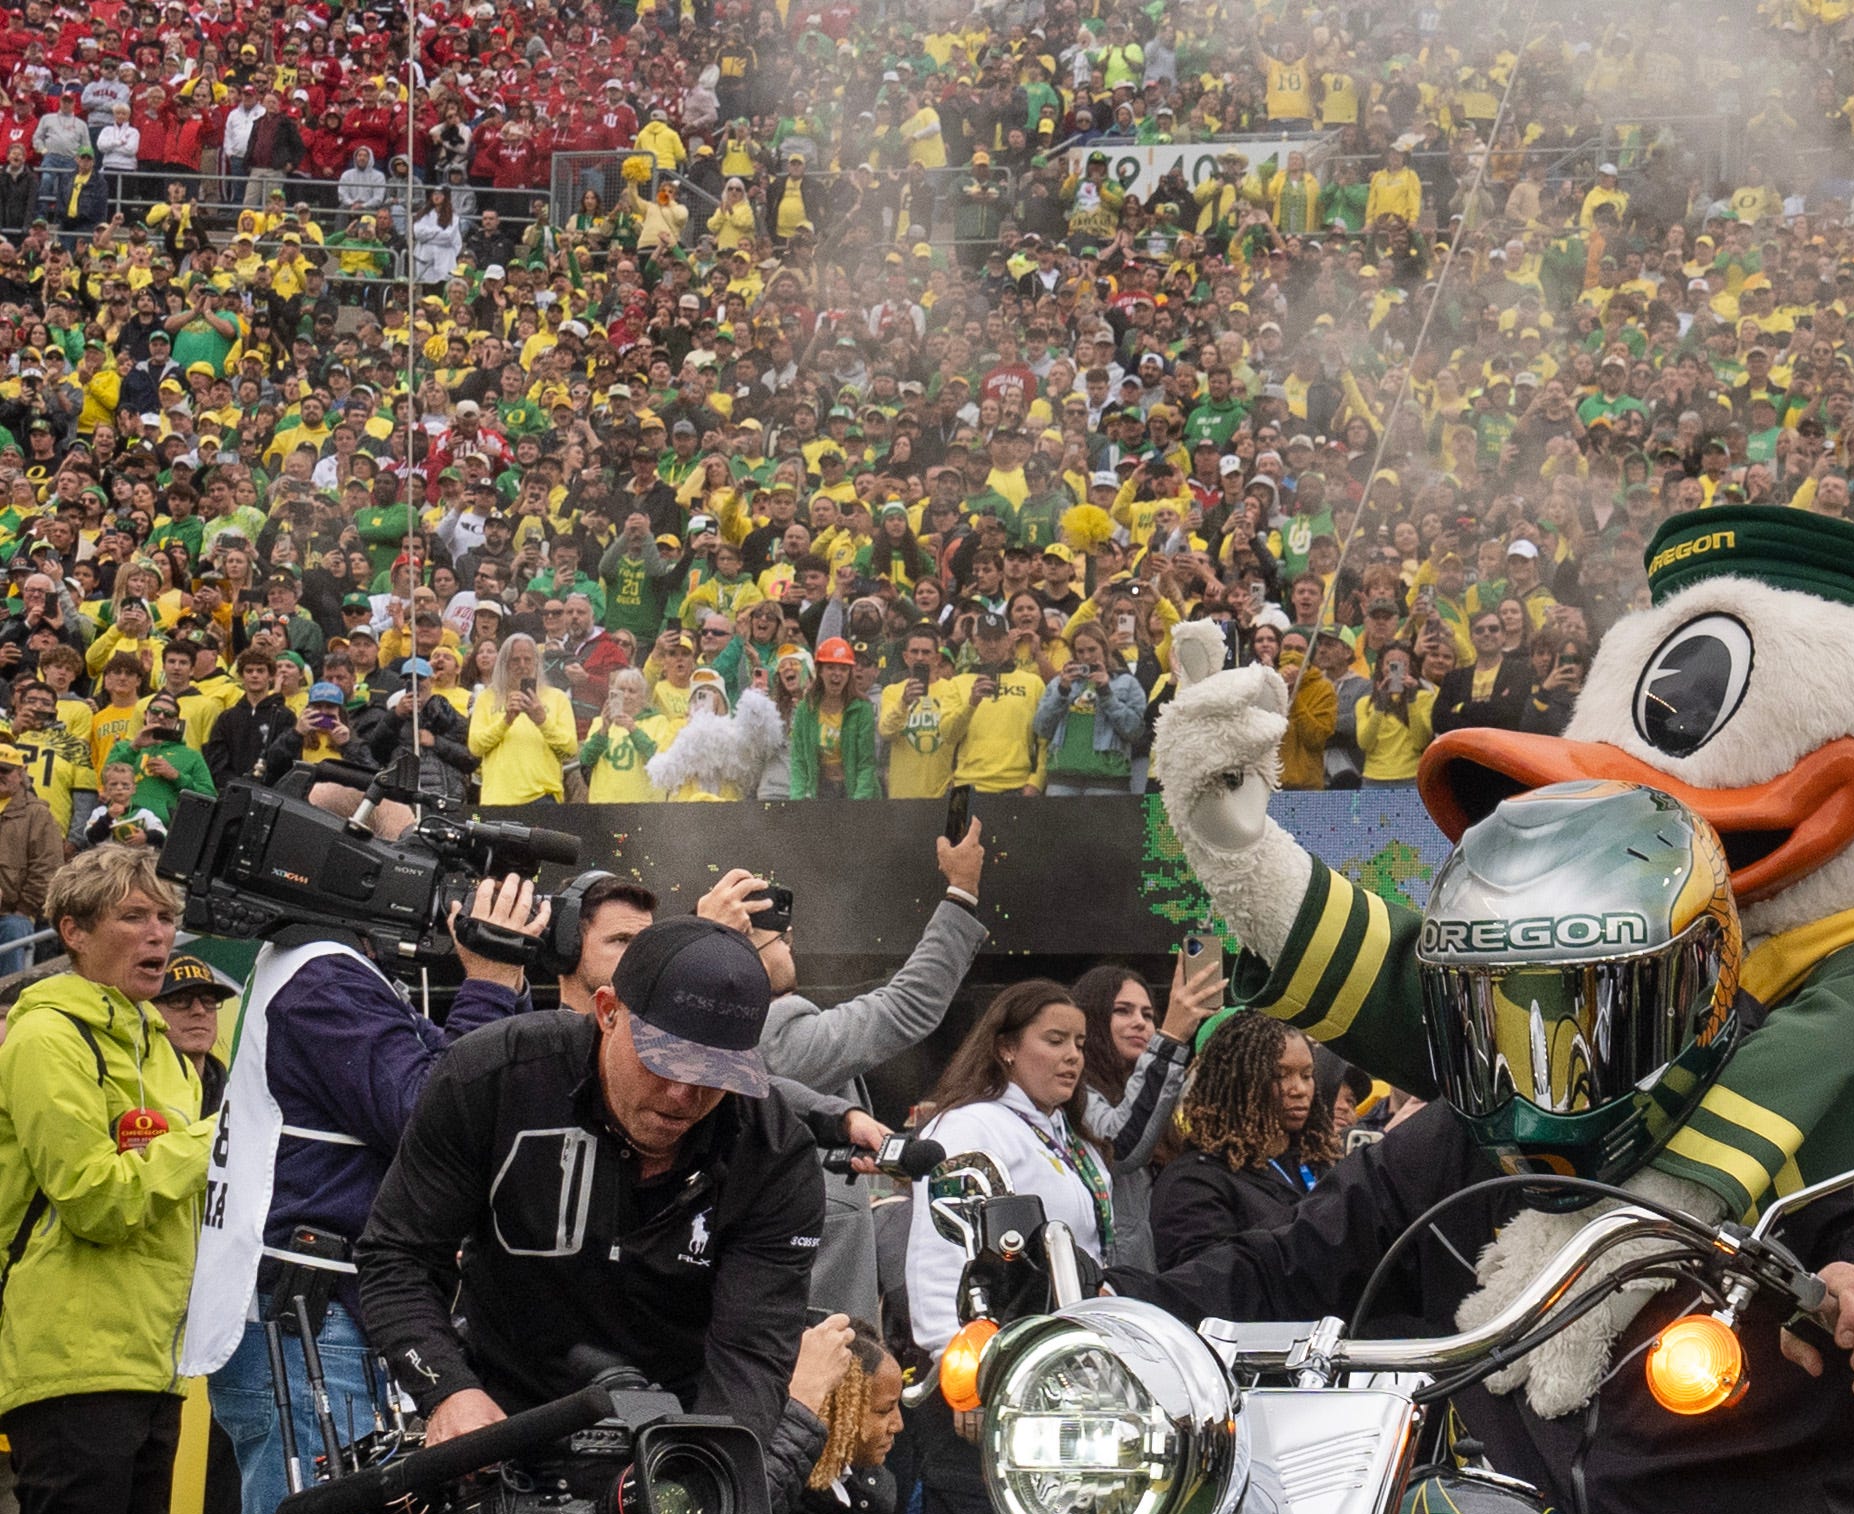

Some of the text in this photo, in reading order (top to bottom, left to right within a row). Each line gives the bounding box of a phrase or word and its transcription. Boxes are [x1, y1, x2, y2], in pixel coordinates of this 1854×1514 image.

[393, 866, 424, 877] SONY
[1419, 910, 1649, 954] OREGON
[173, 965, 213, 983] FIRE
[405, 1347, 441, 1385] RLX
